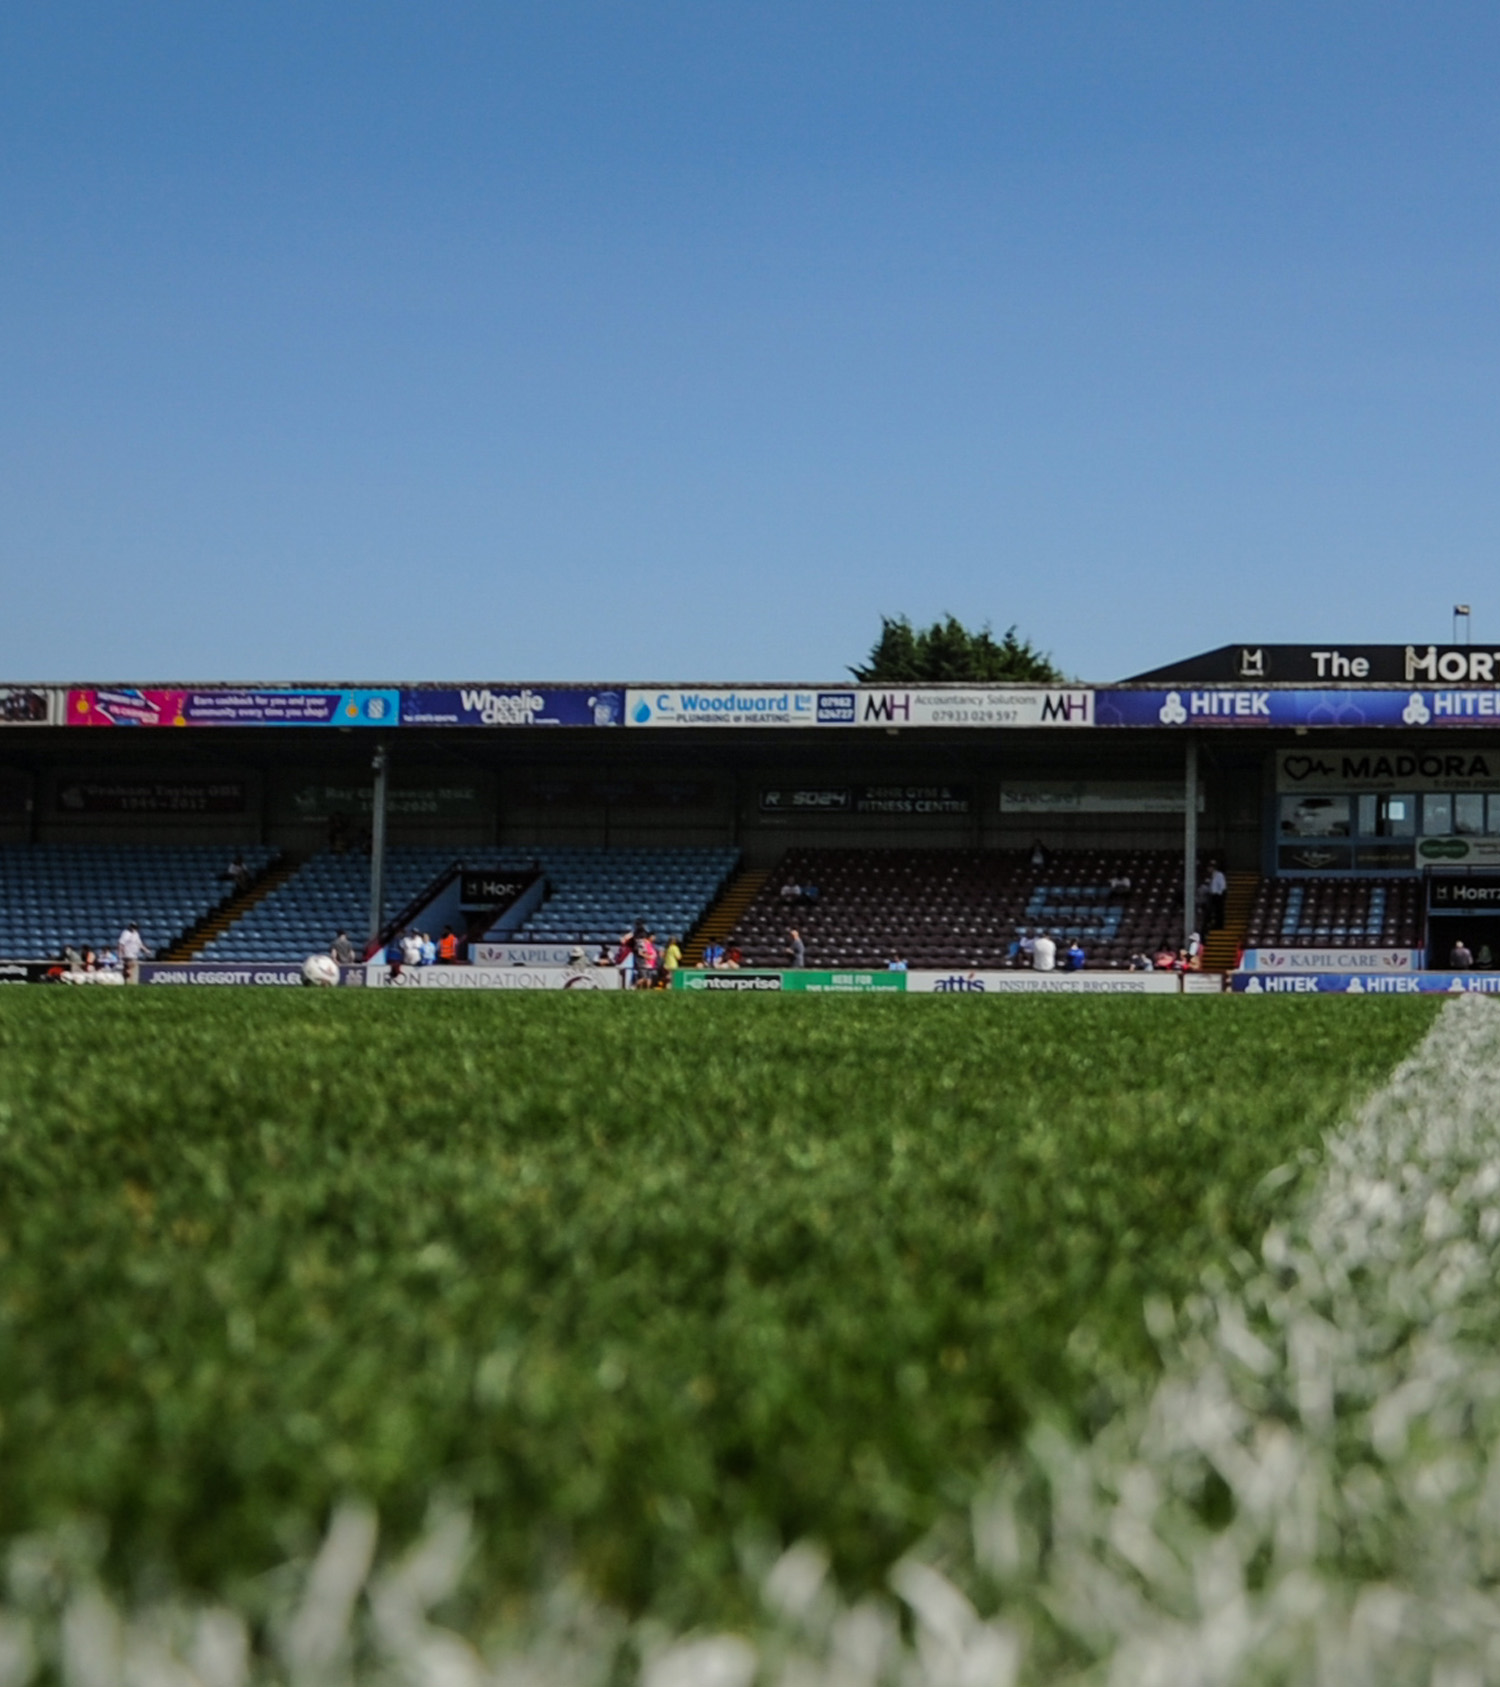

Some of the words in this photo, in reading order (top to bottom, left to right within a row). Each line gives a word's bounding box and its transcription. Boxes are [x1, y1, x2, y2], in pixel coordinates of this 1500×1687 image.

[1311, 652, 1369, 677] The
[193, 695, 214, 706] Earn
[270, 697, 287, 708] you
[288, 695, 305, 705] and
[461, 690, 544, 711] Wheelie
[656, 694, 674, 711] C.
[680, 693, 788, 711] Woodward
[864, 694, 910, 721] MH
[914, 695, 983, 706] Accountancy
[987, 694, 1037, 705] Solutions
[1041, 694, 1087, 721] MH
[1190, 692, 1270, 714] HITEK
[285, 709, 302, 718] you
[481, 708, 534, 725] clean
[676, 714, 730, 723] PLUMBING
[744, 714, 791, 723] HEATING
[1342, 756, 1490, 778] MADORA
[857, 800, 914, 812] FITNESS
[914, 800, 970, 813] CENTRE
[508, 949, 549, 961] KAPIL
[1290, 954, 1335, 967] KAPIL
[1338, 954, 1377, 967] CARE
[150, 971, 187, 984] JOHN
[190, 971, 251, 985] LEGGOTT
[427, 971, 547, 987] FOUNDATION
[690, 974, 781, 990] enterprise
[934, 973, 985, 992] attis
[1000, 980, 1080, 992] INSURANCE
[1084, 980, 1145, 993] BROKERS
[1265, 976, 1318, 992] HITEK
[1366, 976, 1420, 992] HITEK
